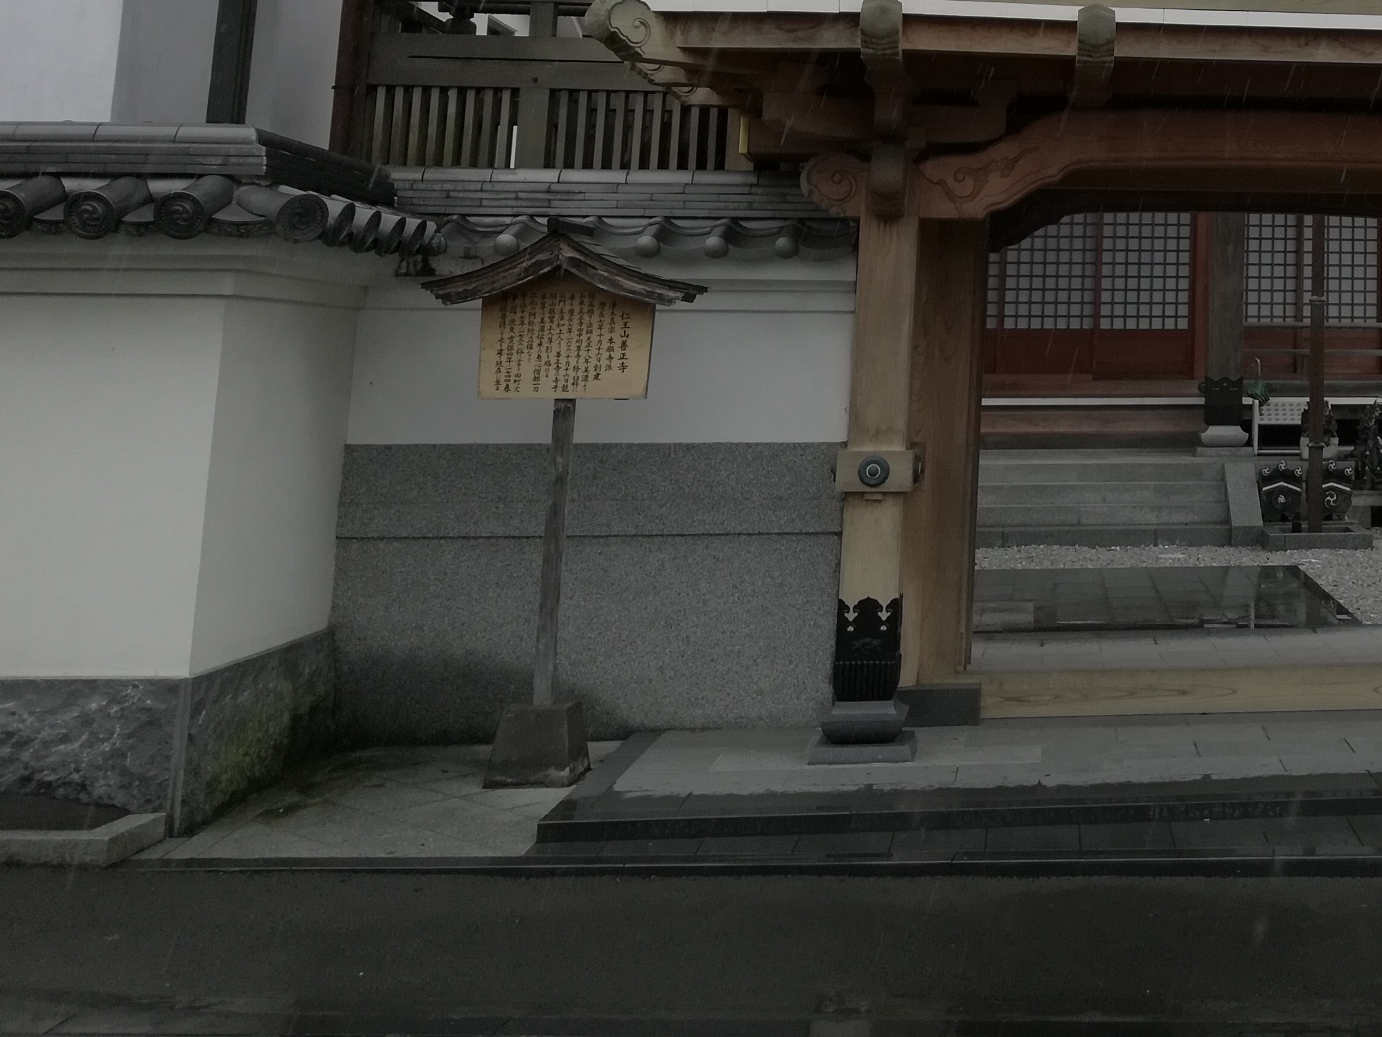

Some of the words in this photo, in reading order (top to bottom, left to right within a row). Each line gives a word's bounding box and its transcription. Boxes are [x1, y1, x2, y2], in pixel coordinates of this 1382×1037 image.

[617, 312, 631, 373] 仁王山善正寺
